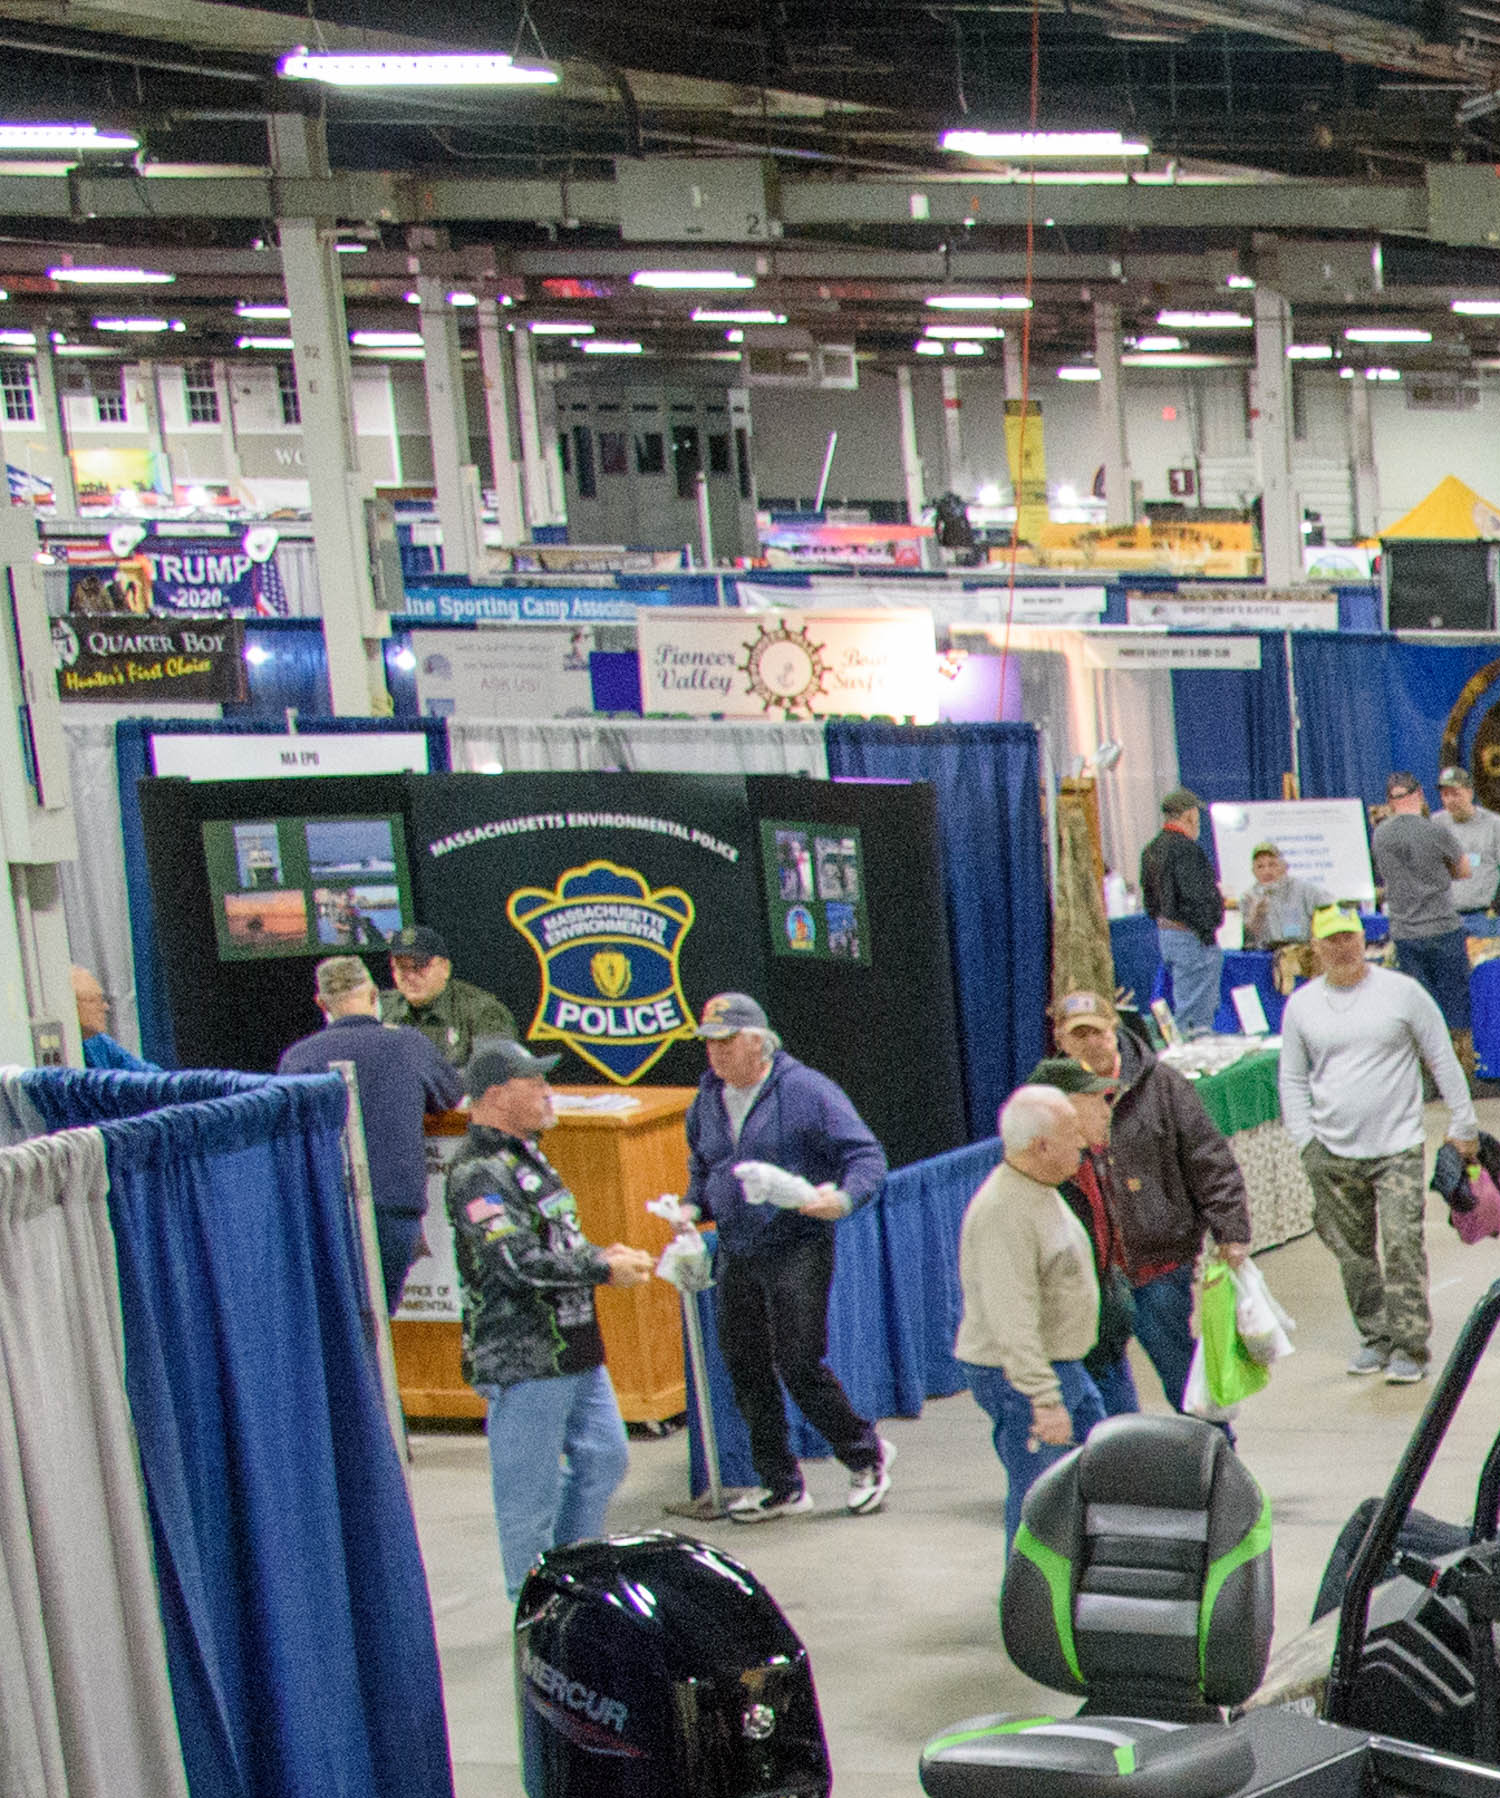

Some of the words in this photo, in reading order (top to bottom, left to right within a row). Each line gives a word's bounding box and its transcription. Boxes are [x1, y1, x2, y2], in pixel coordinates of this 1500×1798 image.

[150, 552, 252, 584] TRUMP
[405, 596, 436, 617] ine
[439, 596, 519, 621] Sporting
[522, 597, 569, 622] Camp
[88, 632, 176, 655] QUAKER
[182, 630, 226, 653] BOY
[655, 645, 737, 666] Pioneer
[66, 659, 126, 690] Hunter's
[128, 657, 164, 682] First
[658, 670, 732, 698] Valley
[430, 813, 565, 857] MASSACHUSETTS
[566, 812, 691, 841] ENVIRONMENTAL
[688, 828, 740, 863] POLICE
[543, 903, 668, 931] MASSACHUSETTS
[544, 919, 666, 945] ENVIRONMENTAL
[555, 1001, 681, 1037] POLICE
[520, 1650, 629, 1732] MERCUR
